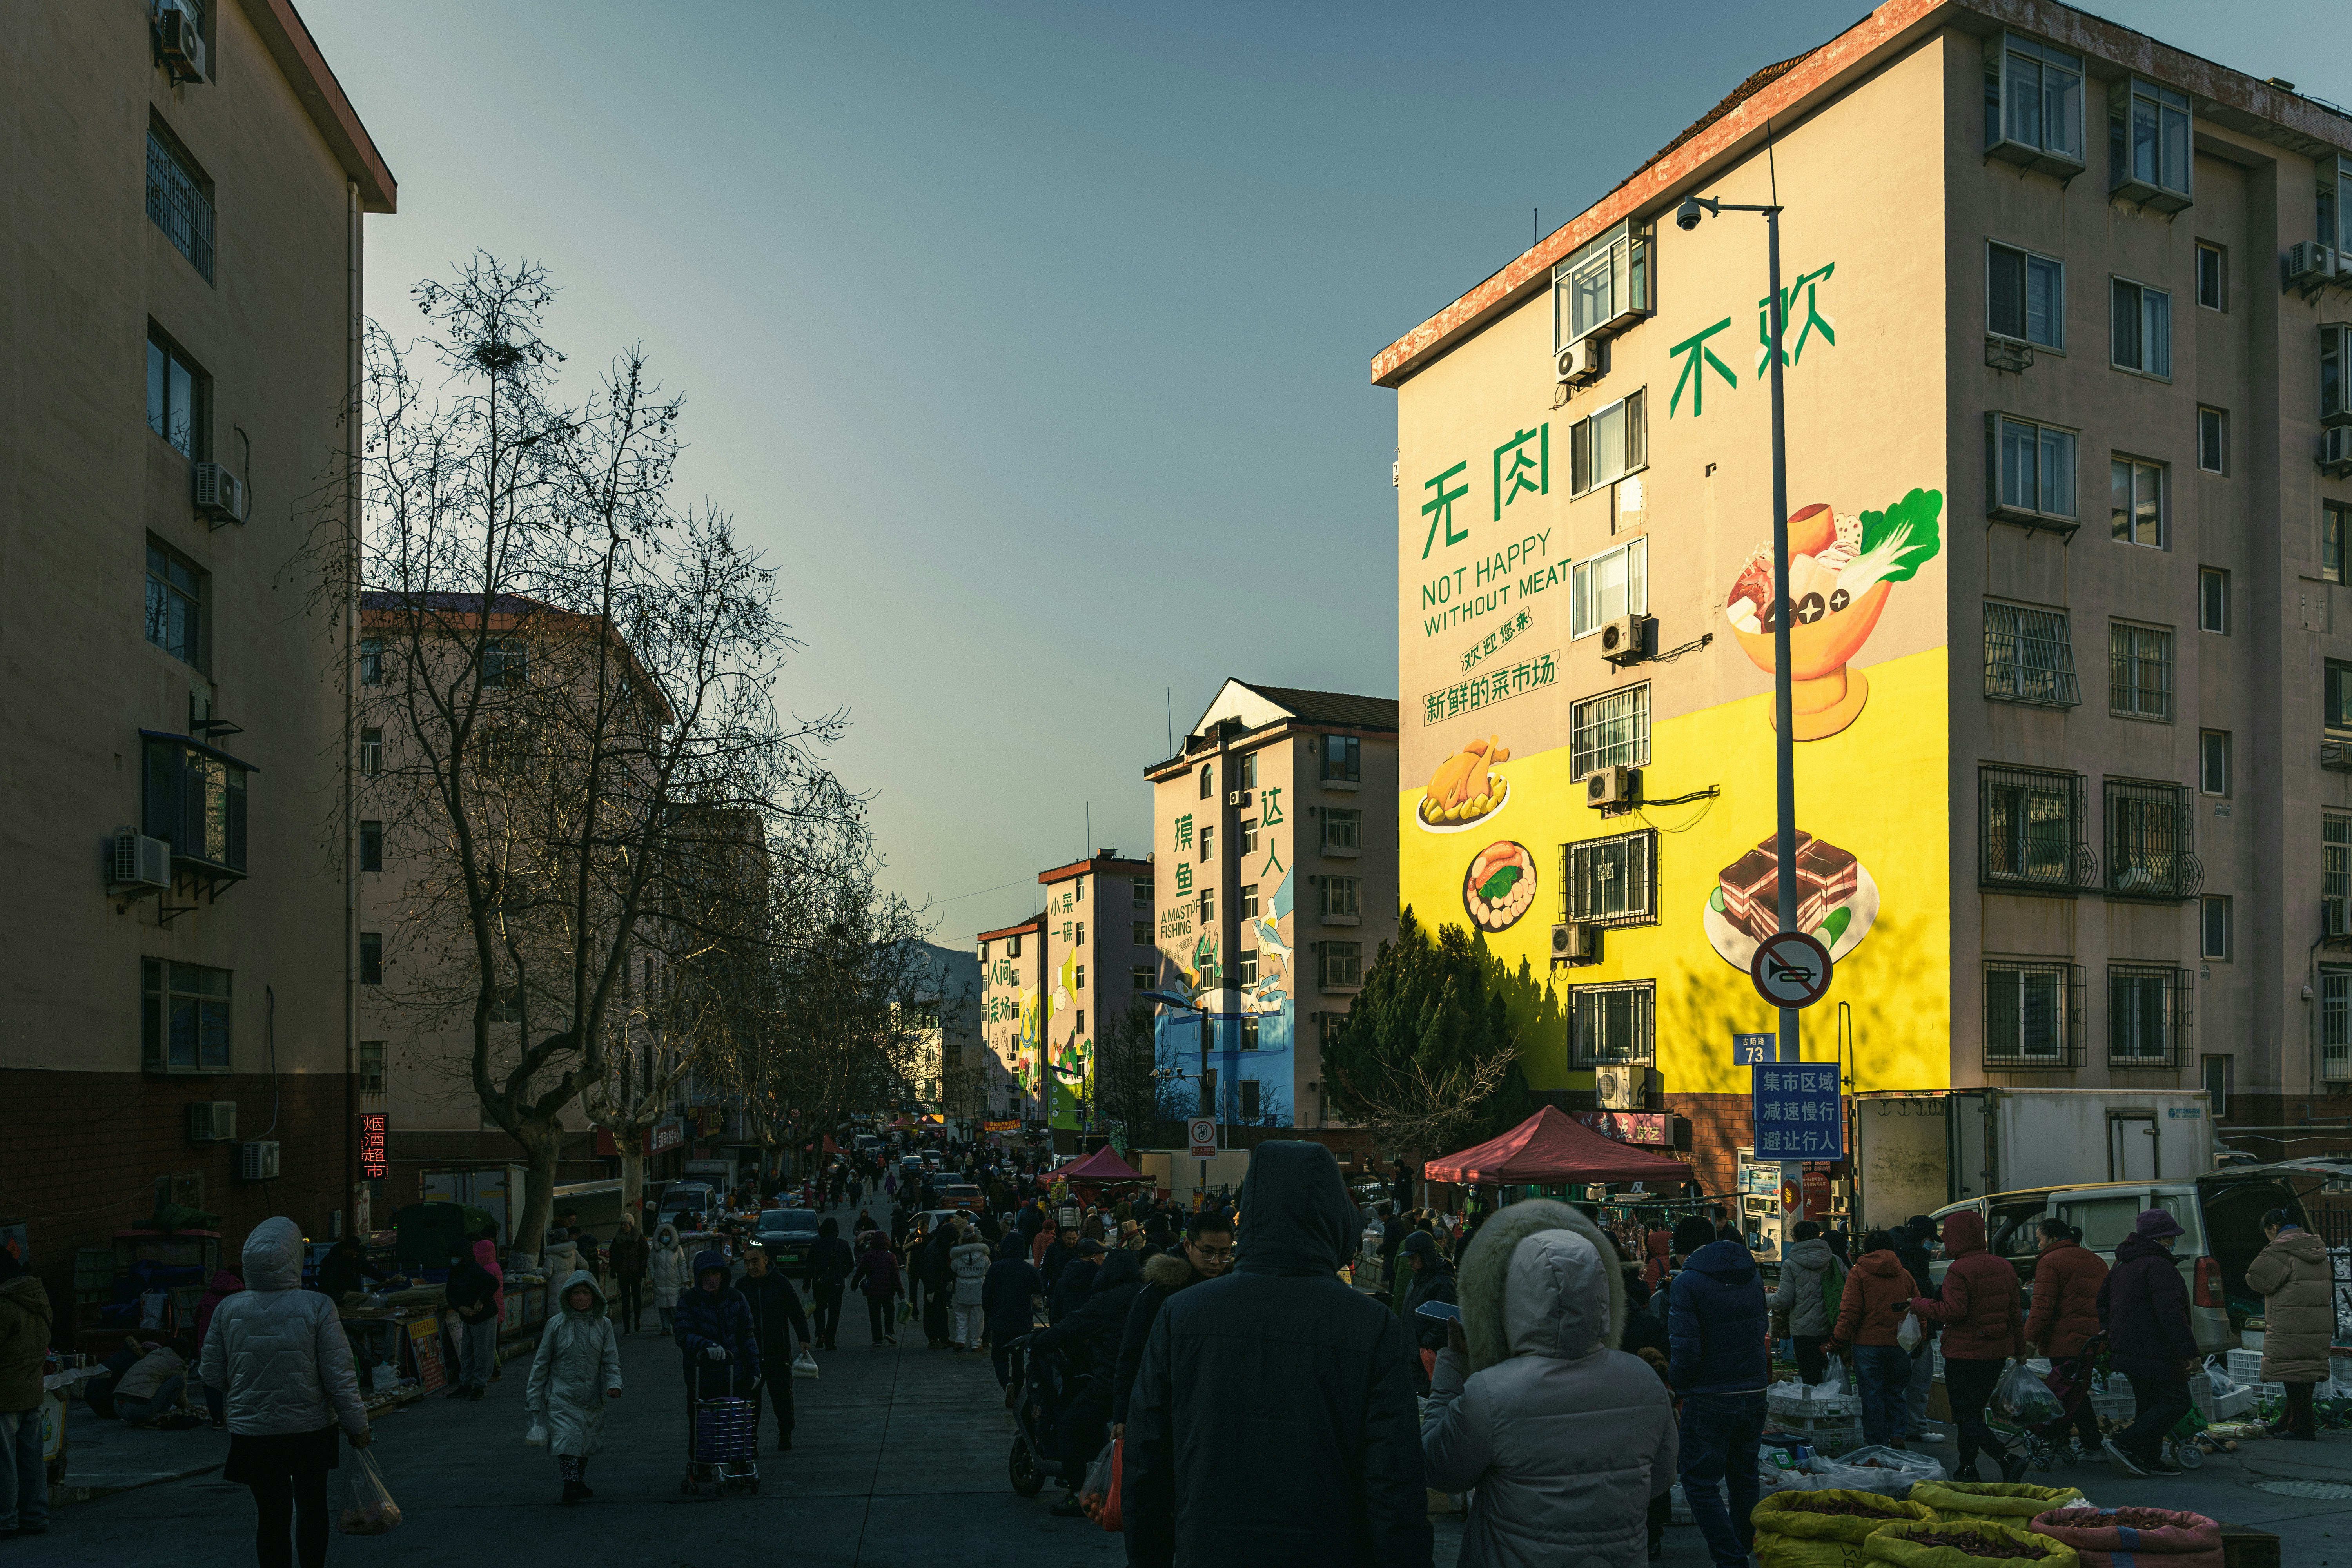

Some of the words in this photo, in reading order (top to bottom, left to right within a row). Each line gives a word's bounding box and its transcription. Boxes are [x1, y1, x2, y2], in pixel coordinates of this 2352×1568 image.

[1422, 422, 1549, 559] 无肉
[1670, 262, 1835, 419] 不欢
[1423, 567, 1466, 610] NOT
[1477, 528, 1551, 587] HAPPY
[1424, 585, 1510, 637] WITHOUT
[1519, 558, 1572, 599] MEAT
[1464, 612, 1529, 671] 欢迎您来
[1427, 654, 1555, 722] 新鲜的菜市场
[1261, 787, 1284, 877] 达人
[1175, 813, 1193, 897] 摸鱼
[1051, 893, 1073, 916] 小菜
[1051, 920, 1073, 942] 一碟
[1161, 920, 1191, 939] FISHING
[1160, 946, 1184, 965] 新鲜的菜市场
[1179, 937, 1192, 950] 欢迎您来
[990, 958, 1011, 986] 人间
[990, 996, 1011, 1024] 菜场
[1742, 1037, 1764, 1046] 古陌路
[1746, 1047, 1764, 1062] 73
[1763, 1071, 1834, 1092] 集市区域
[1763, 1101, 1835, 1122] 减速慢行
[363, 1117, 386, 1178] 烟酒超市
[1762, 1131, 1835, 1151] 避让行人
